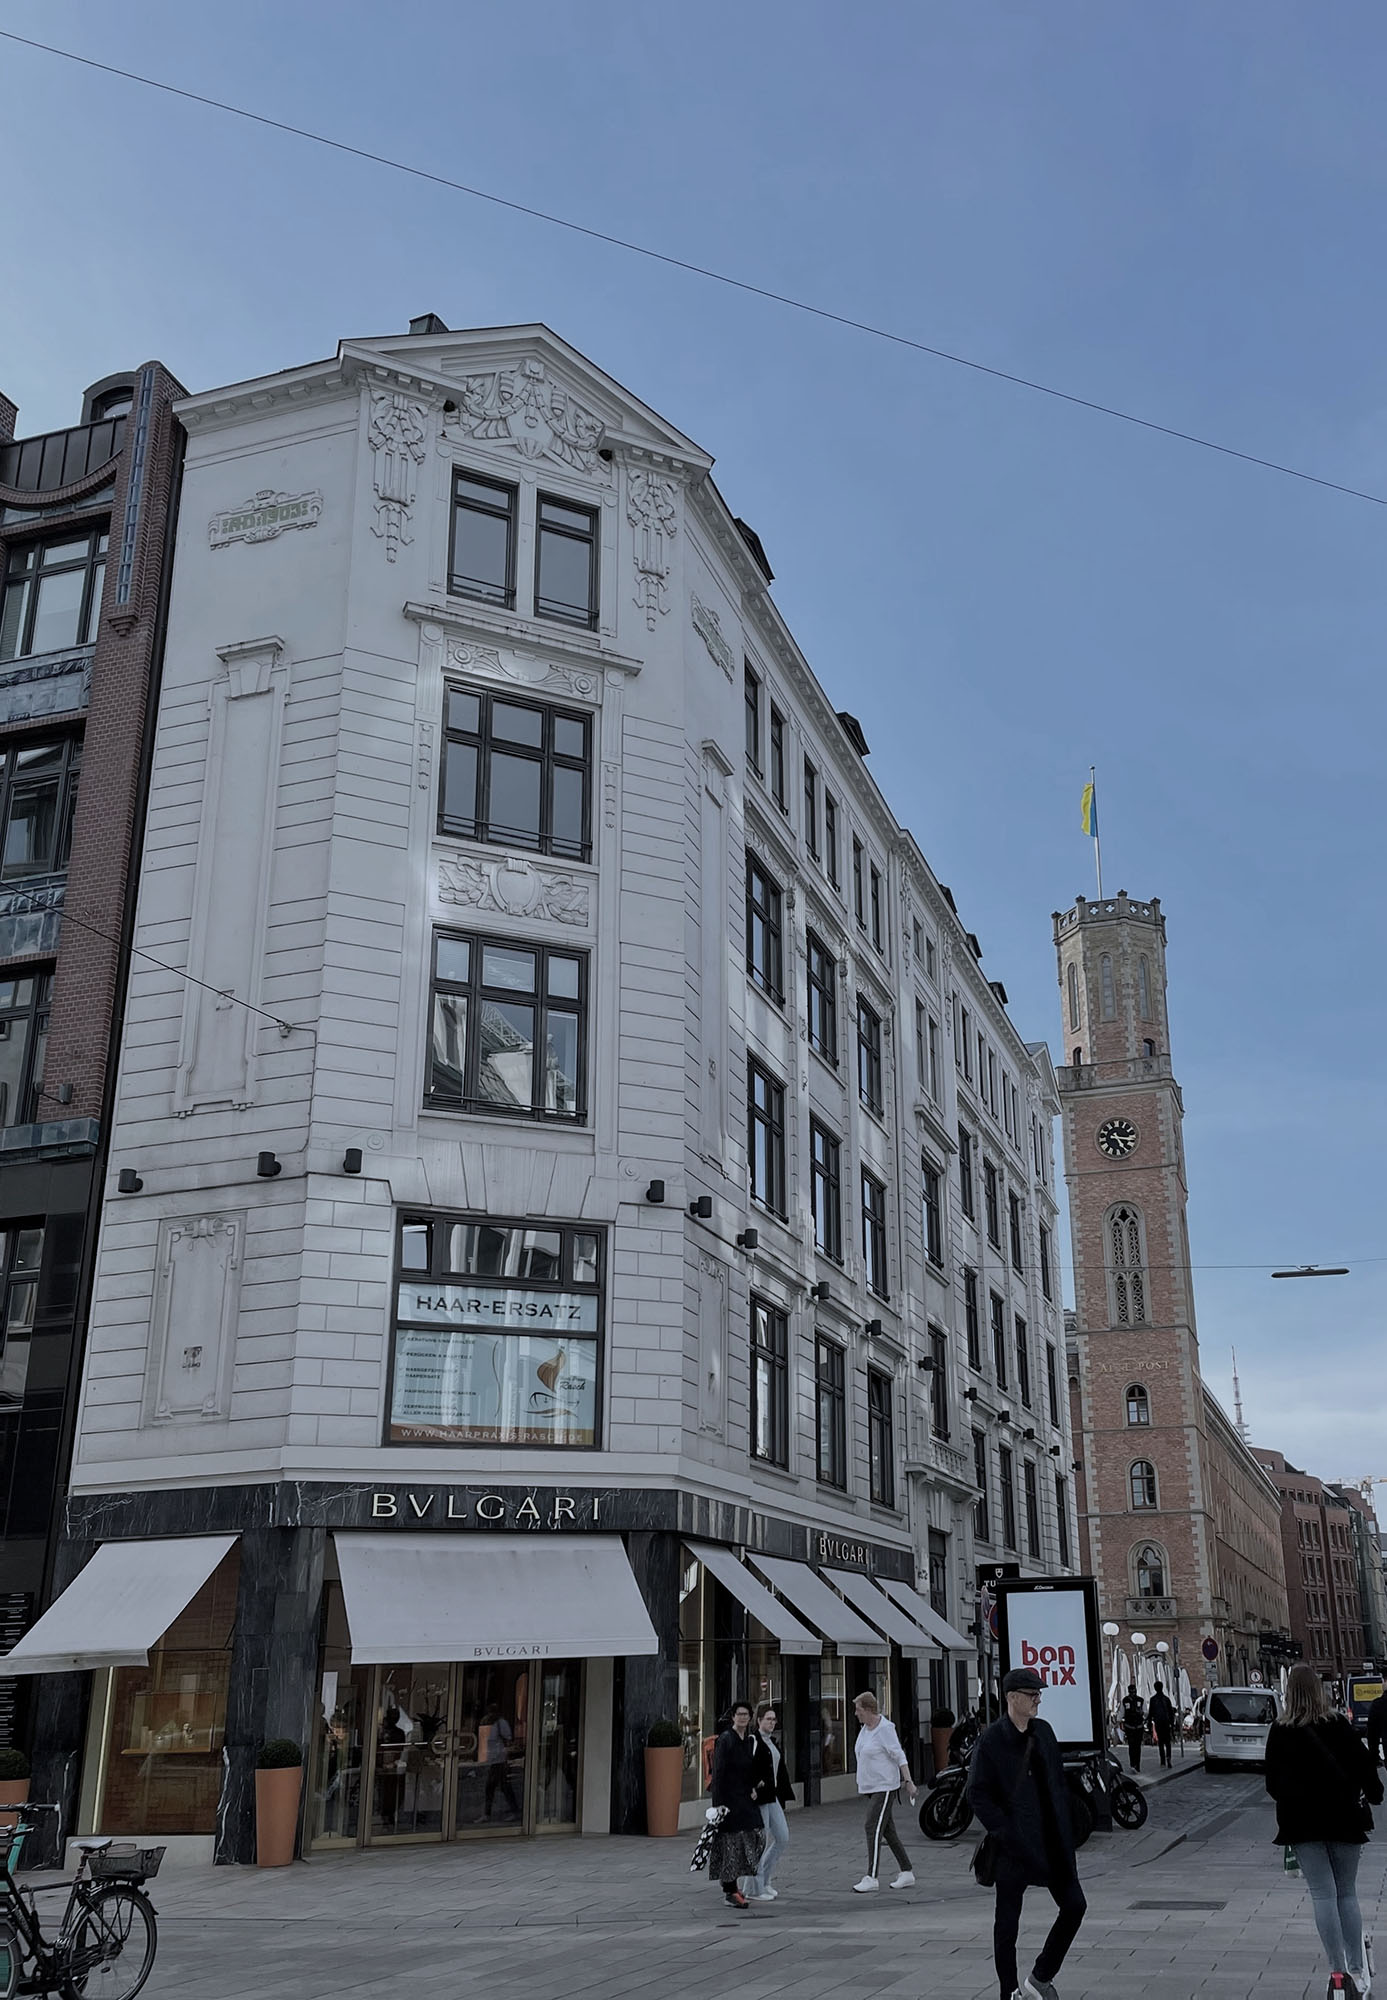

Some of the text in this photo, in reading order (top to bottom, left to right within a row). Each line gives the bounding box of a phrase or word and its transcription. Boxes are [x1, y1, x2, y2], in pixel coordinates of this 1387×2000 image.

[416, 1295, 581, 1320] HAAR-ERSATZ
[371, 1492, 599, 1521] BVLGARI
[820, 1537, 869, 1565] BVLGARI
[473, 1645, 549, 1657] BVLGARI
[1021, 1640, 1075, 1666] bon
